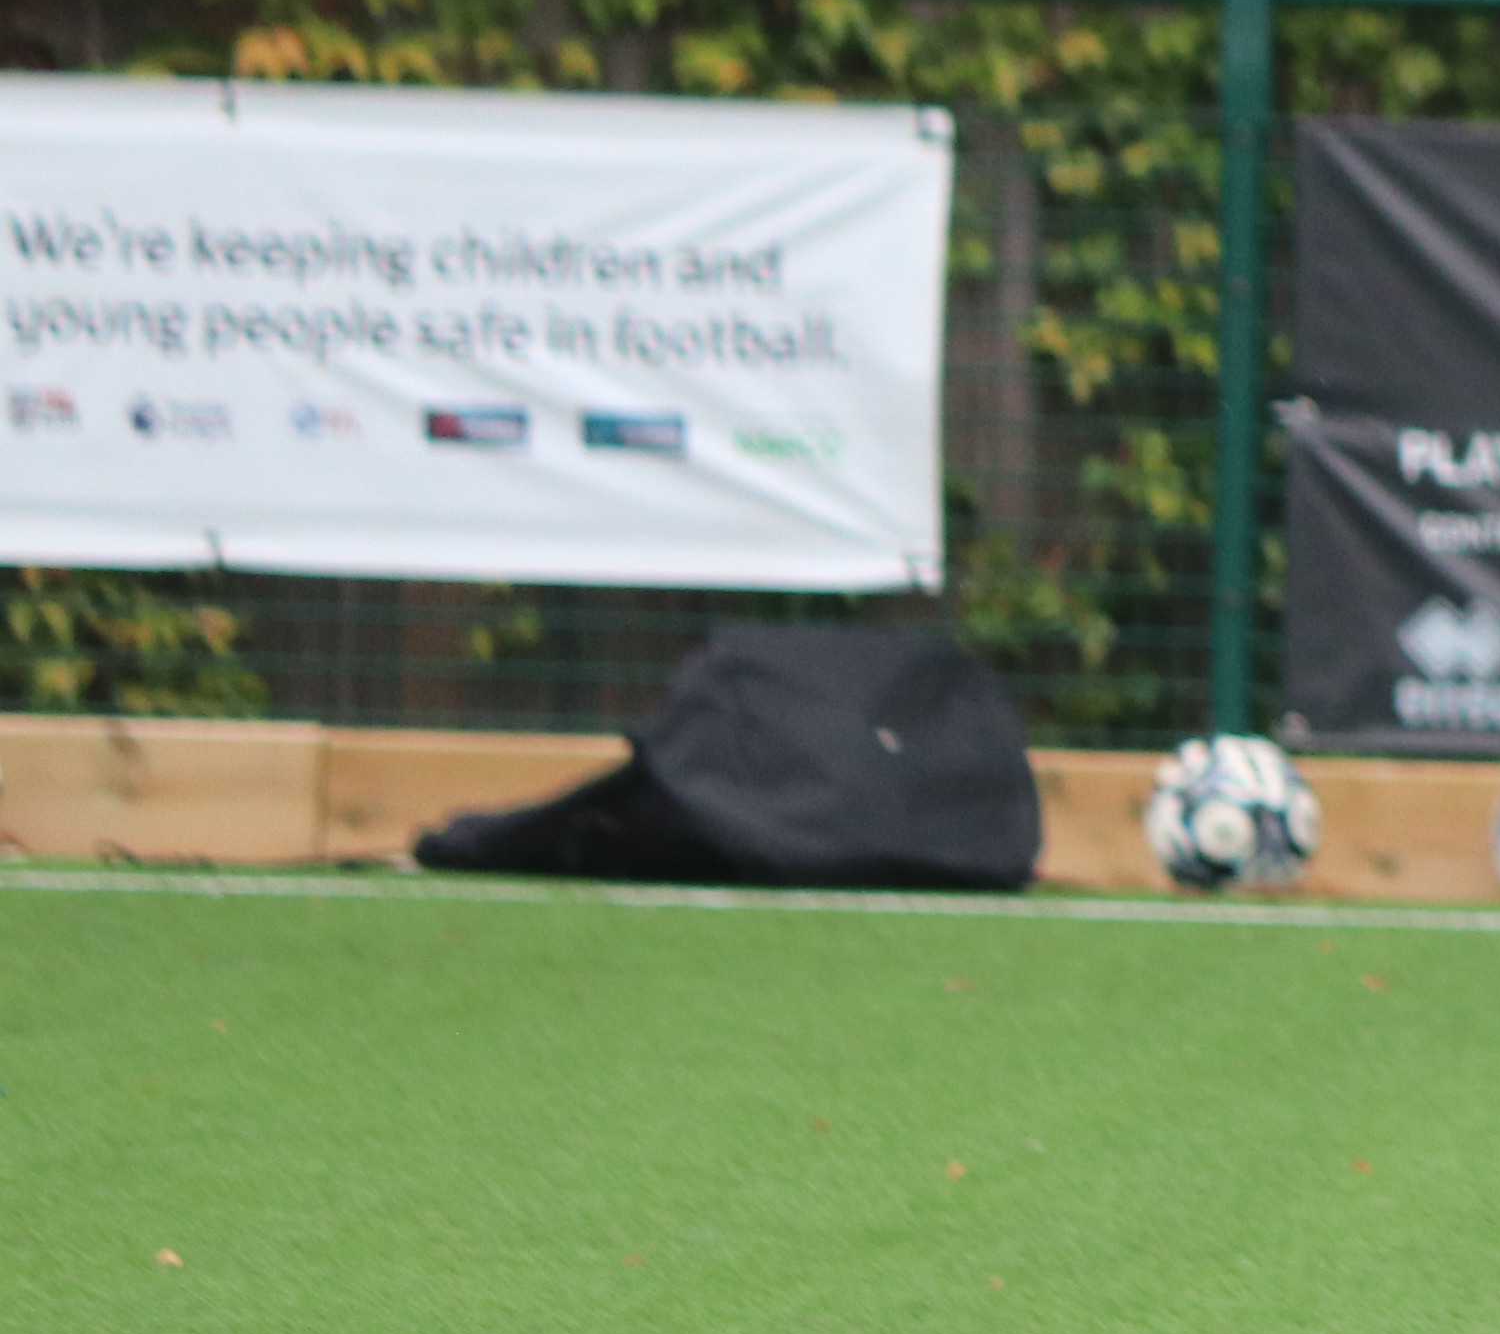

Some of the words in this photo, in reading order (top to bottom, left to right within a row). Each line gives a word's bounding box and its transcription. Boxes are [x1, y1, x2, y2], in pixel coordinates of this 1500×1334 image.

[5, 208, 176, 265] We're
[190, 216, 417, 290] keeping
[430, 224, 661, 289] children
[676, 237, 784, 294] and
[5, 297, 190, 362] young
[200, 295, 402, 365] people
[414, 300, 531, 359] safe
[545, 302, 600, 359] in
[613, 303, 846, 367] football.
